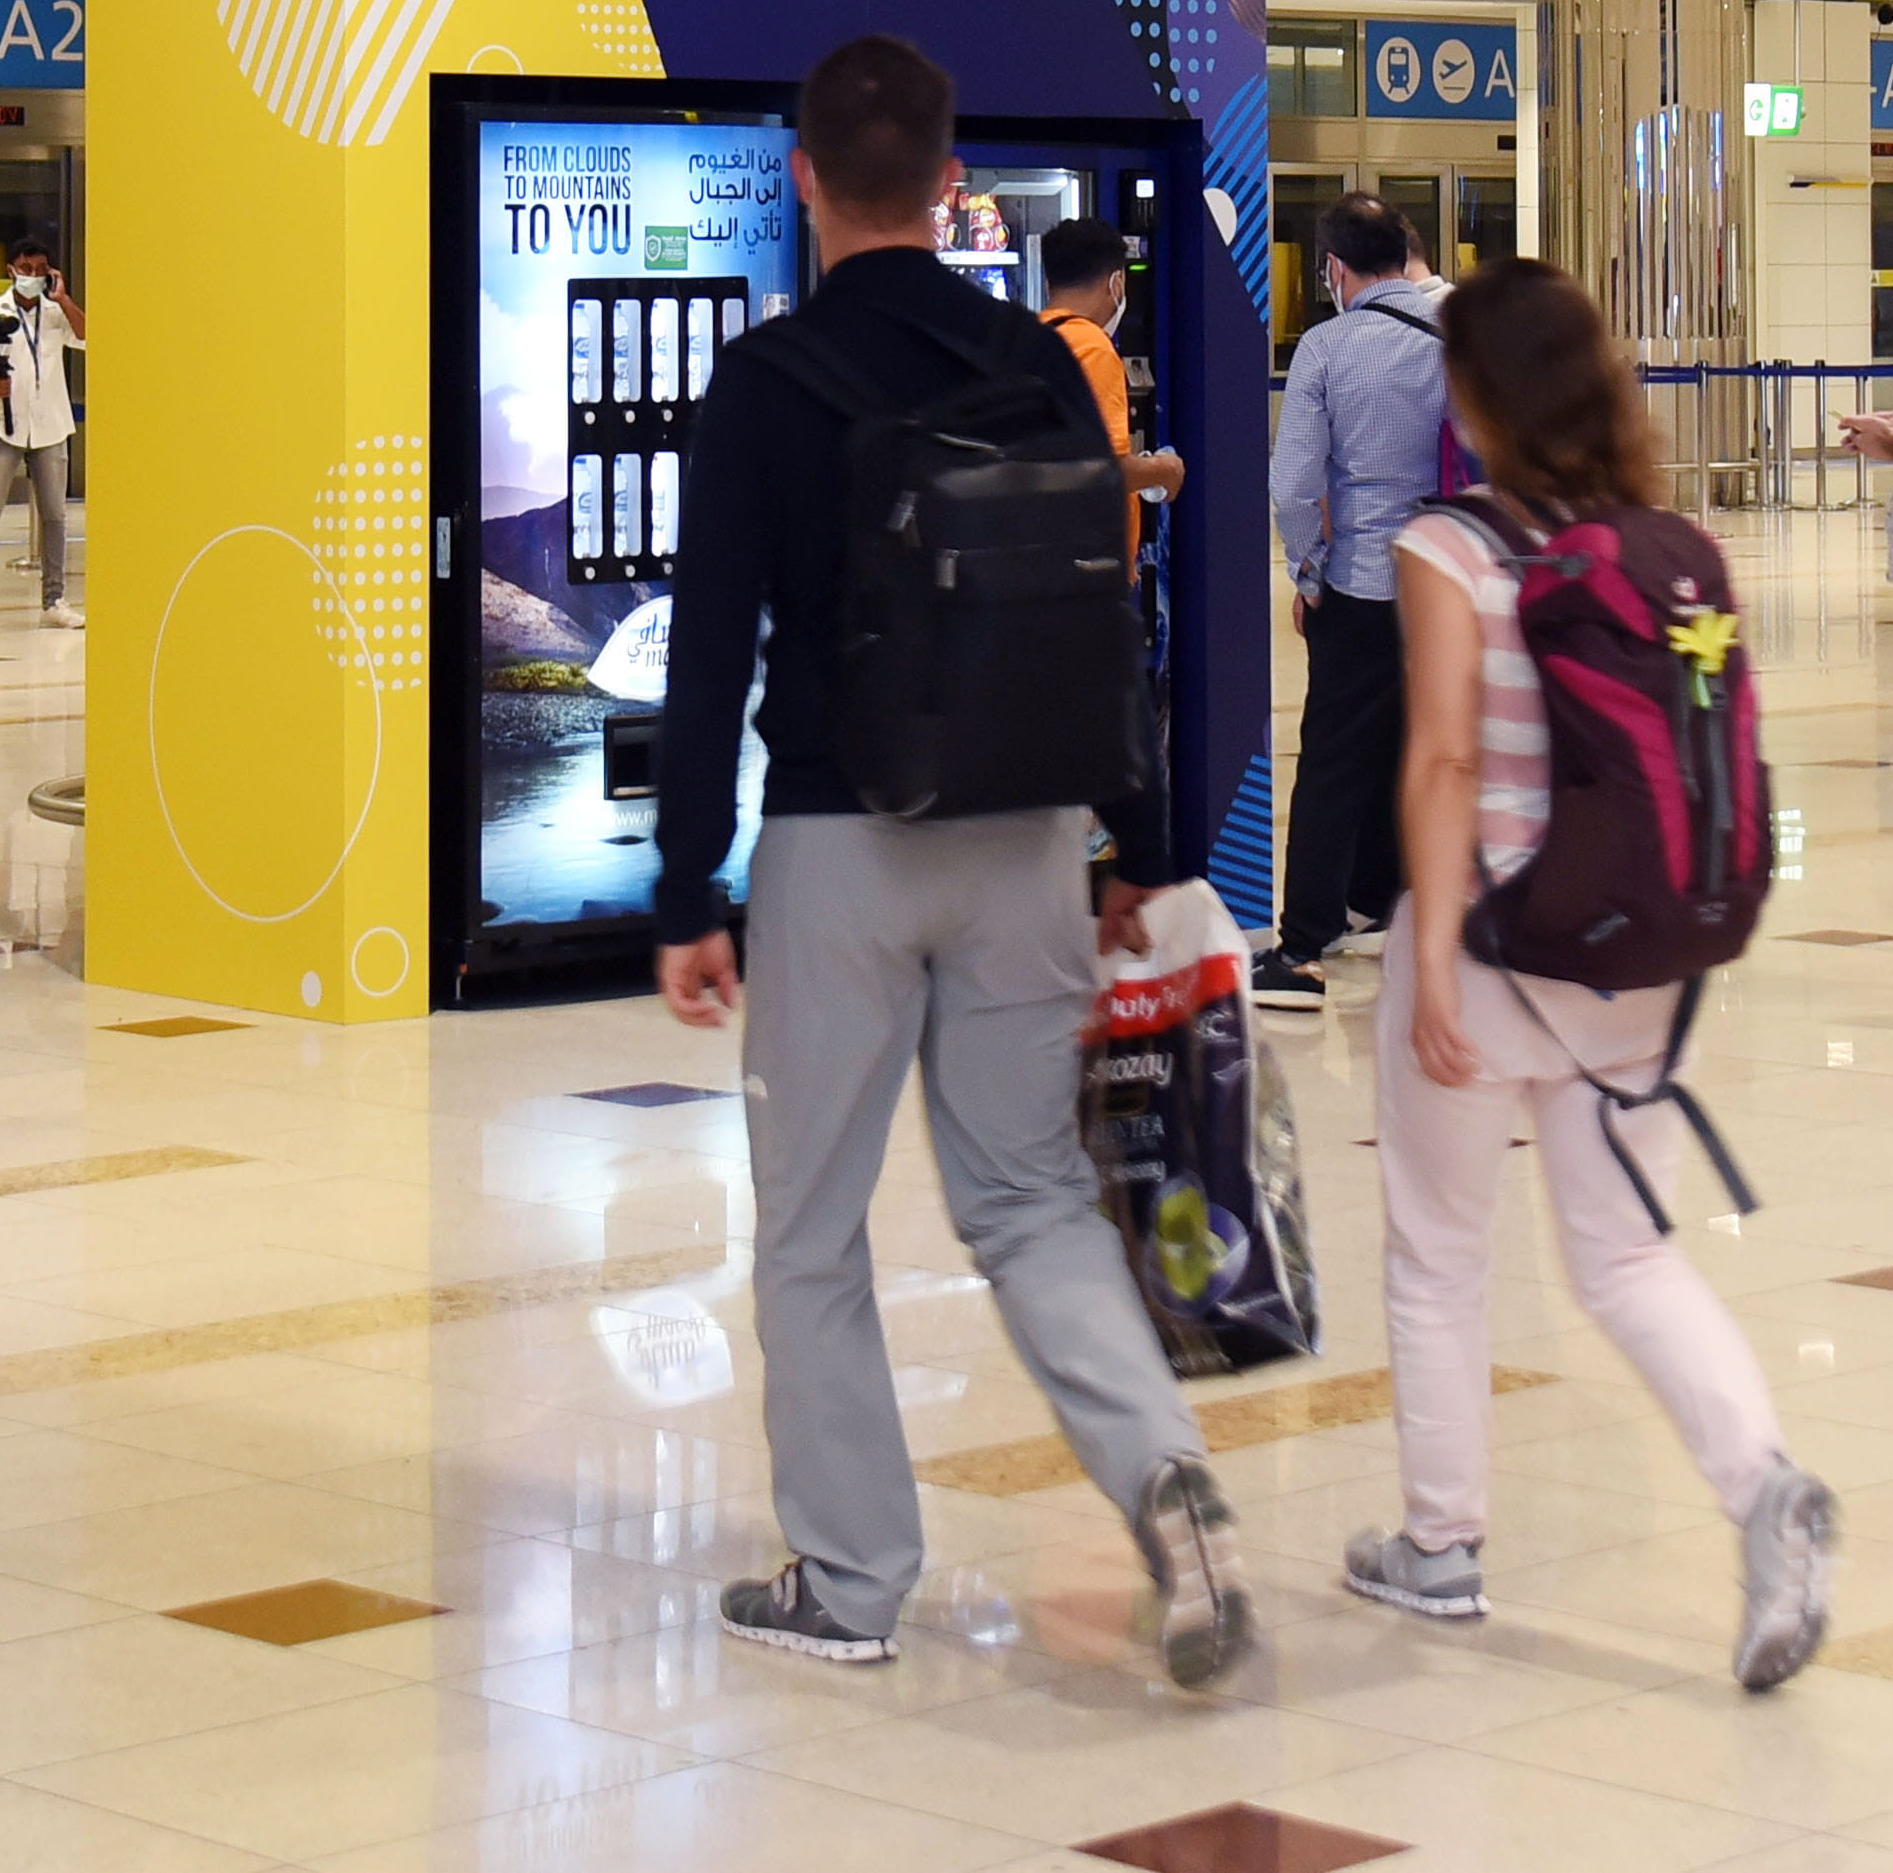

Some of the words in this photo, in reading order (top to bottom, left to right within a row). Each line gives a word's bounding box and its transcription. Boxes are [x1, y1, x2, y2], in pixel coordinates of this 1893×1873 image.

[503, 145, 557, 172] FROM
[563, 146, 631, 172] CLOUDS
[758, 148, 782, 175] من
[506, 175, 526, 199] TO
[533, 175, 631, 199] MOUNTAINS
[504, 204, 550, 254] TO
[565, 204, 631, 254] YOU
